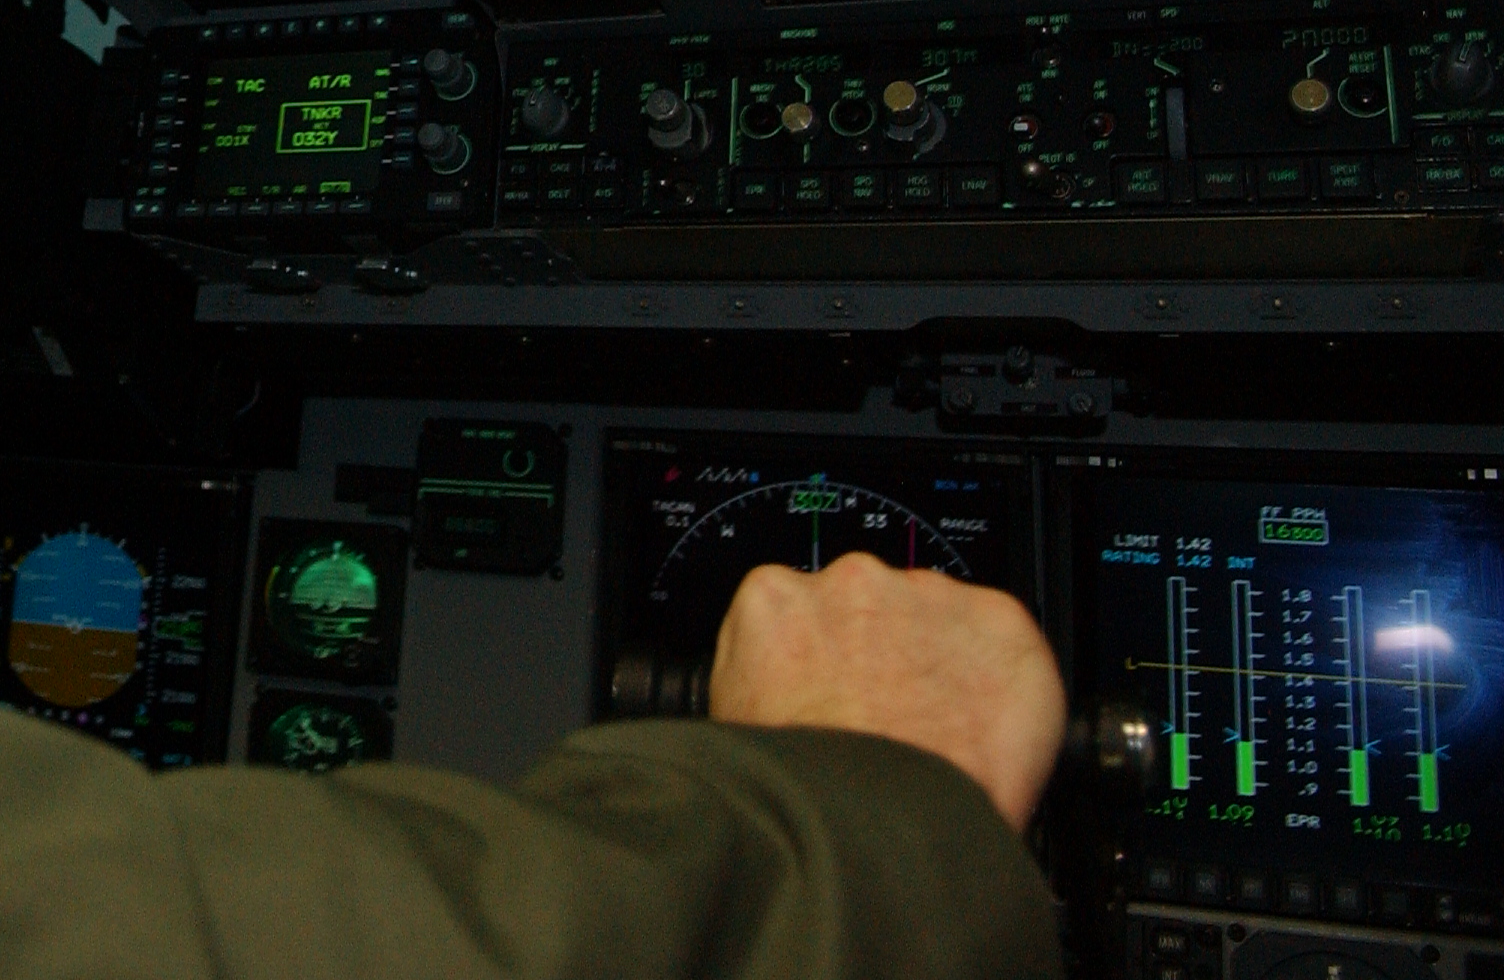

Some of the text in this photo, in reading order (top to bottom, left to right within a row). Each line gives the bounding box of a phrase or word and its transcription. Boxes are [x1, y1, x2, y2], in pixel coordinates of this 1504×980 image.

[235, 78, 266, 93] TAC
[307, 74, 352, 90] AT/R
[300, 106, 343, 121] TNKR
[291, 130, 339, 147] 032Y
[1018, 142, 1034, 154] OFF
[795, 492, 837, 510] 307
[1260, 505, 1283, 519] FF
[862, 513, 888, 529] 33
[1113, 533, 1213, 552] LIMIT 1.42
[1100, 548, 1161, 565] RATING
[1175, 553, 1213, 569] 1.42
[1281, 588, 1313, 604] 1.8
[1282, 609, 1313, 624] 1.7
[1282, 630, 1314, 646] 1.6
[1283, 651, 1315, 667] 1.5
[1285, 694, 1316, 710] 1.3
[1285, 716, 1317, 731] 1.2
[1286, 737, 1316, 752] 1.1
[1286, 758, 1318, 774] 1.0
[1285, 813, 1321, 829] EPR
